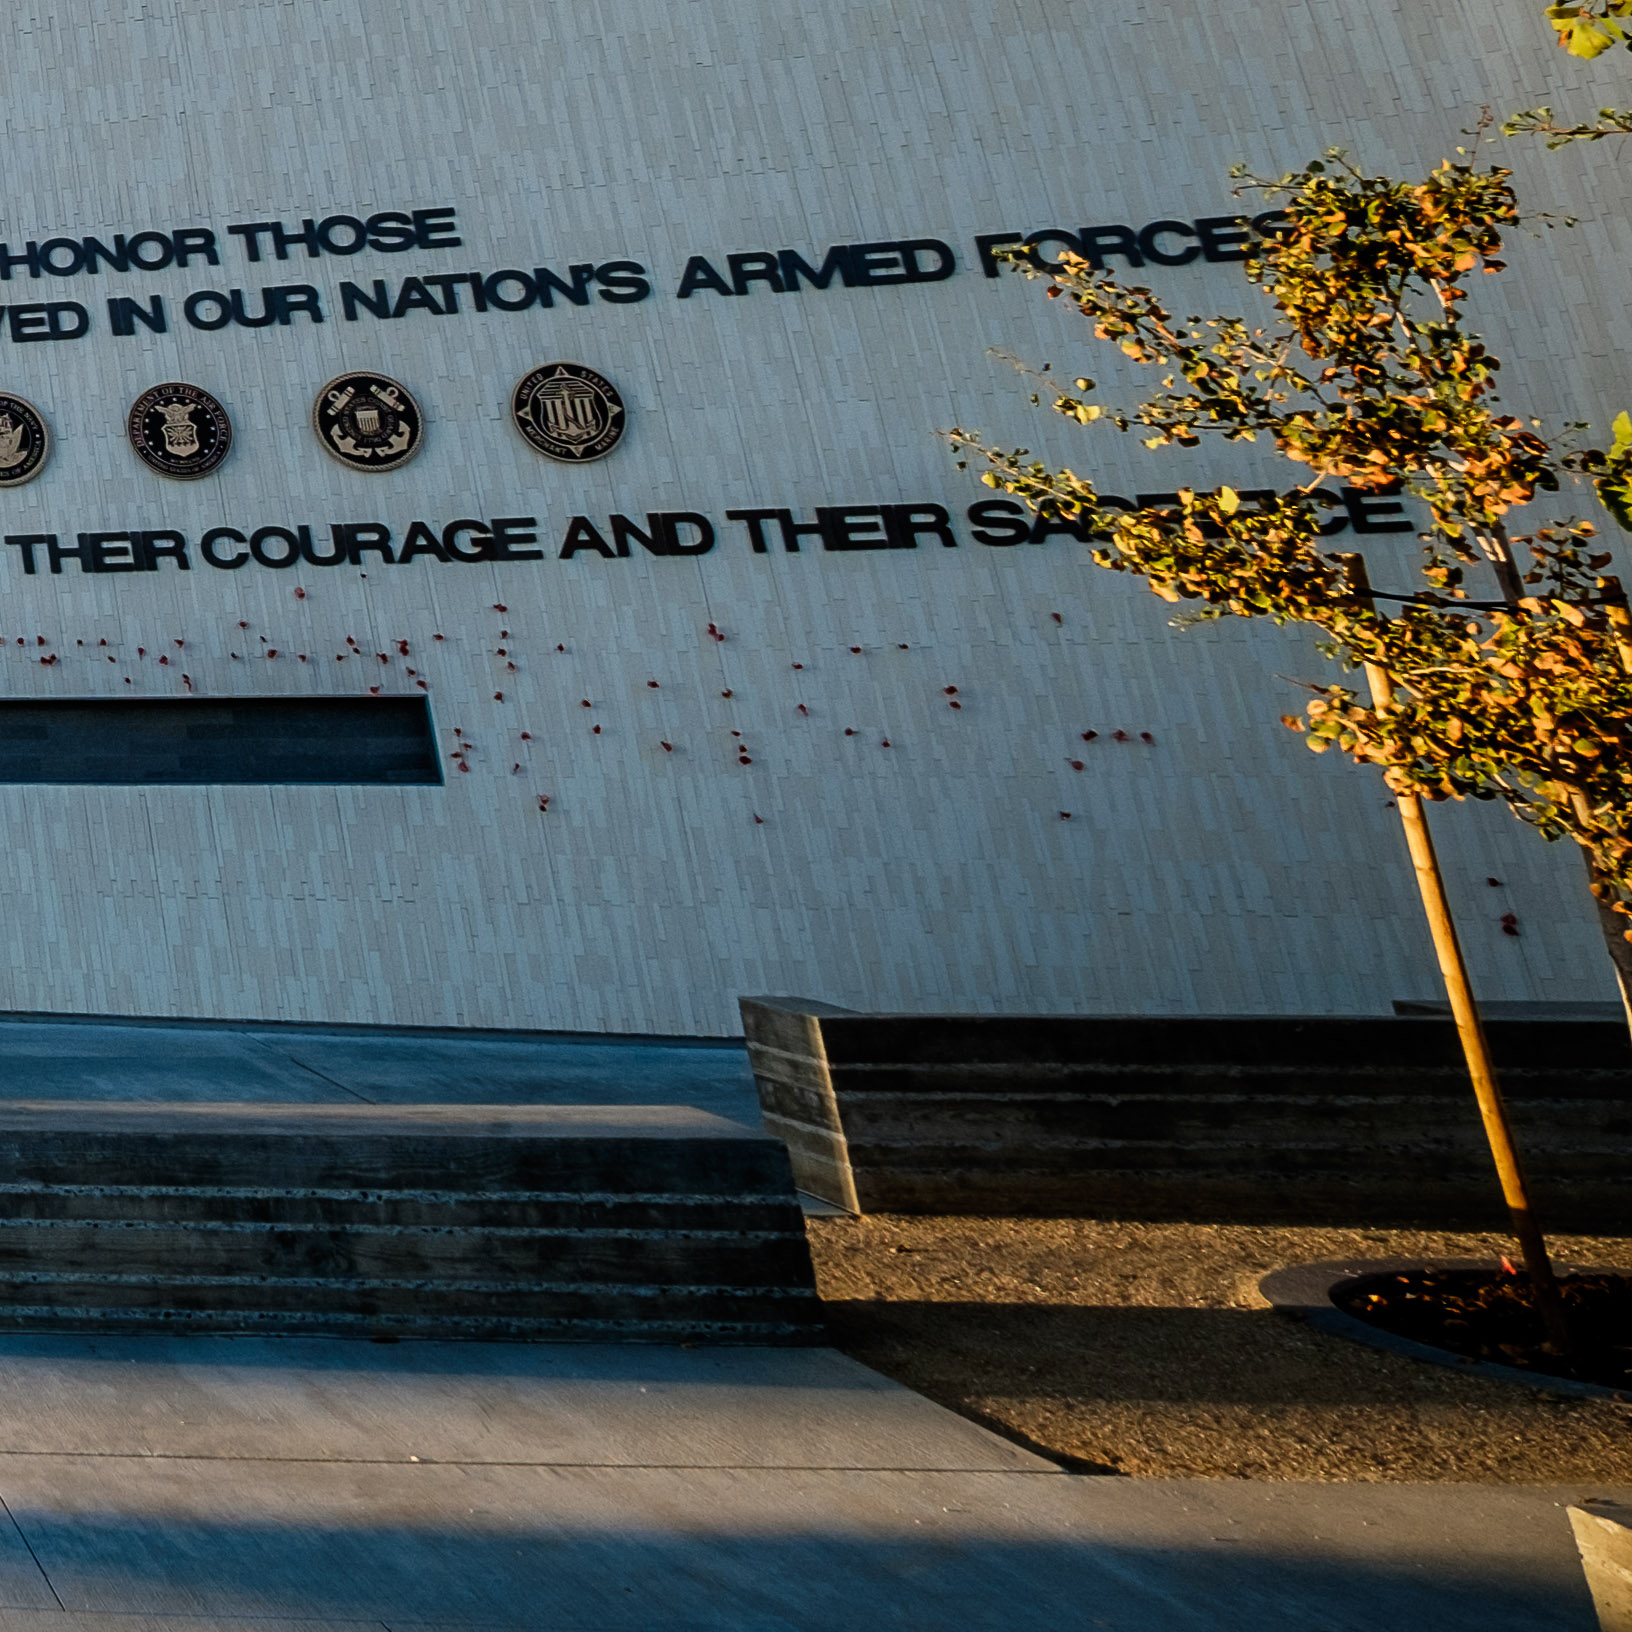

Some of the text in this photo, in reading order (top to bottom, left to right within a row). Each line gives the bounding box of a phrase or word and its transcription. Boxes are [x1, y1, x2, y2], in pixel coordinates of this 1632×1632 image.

[226, 207, 462, 264] THOSE
[109, 291, 164, 338] IN
[183, 282, 323, 331] OUR
[341, 259, 651, 322] NATION'S
[676, 238, 956, 299] ARMED
[520, 370, 614, 400] UNITED STATES
[178, 386, 198, 398] THE
[199, 395, 217, 411] AIR
[213, 409, 229, 443] FORCE
[525, 425, 620, 455] MERCHANT MARINE
[5, 528, 189, 576] THEIR
[199, 517, 544, 571] COURAGE
[559, 511, 716, 561] AND
[726, 502, 957, 555] THEIR
